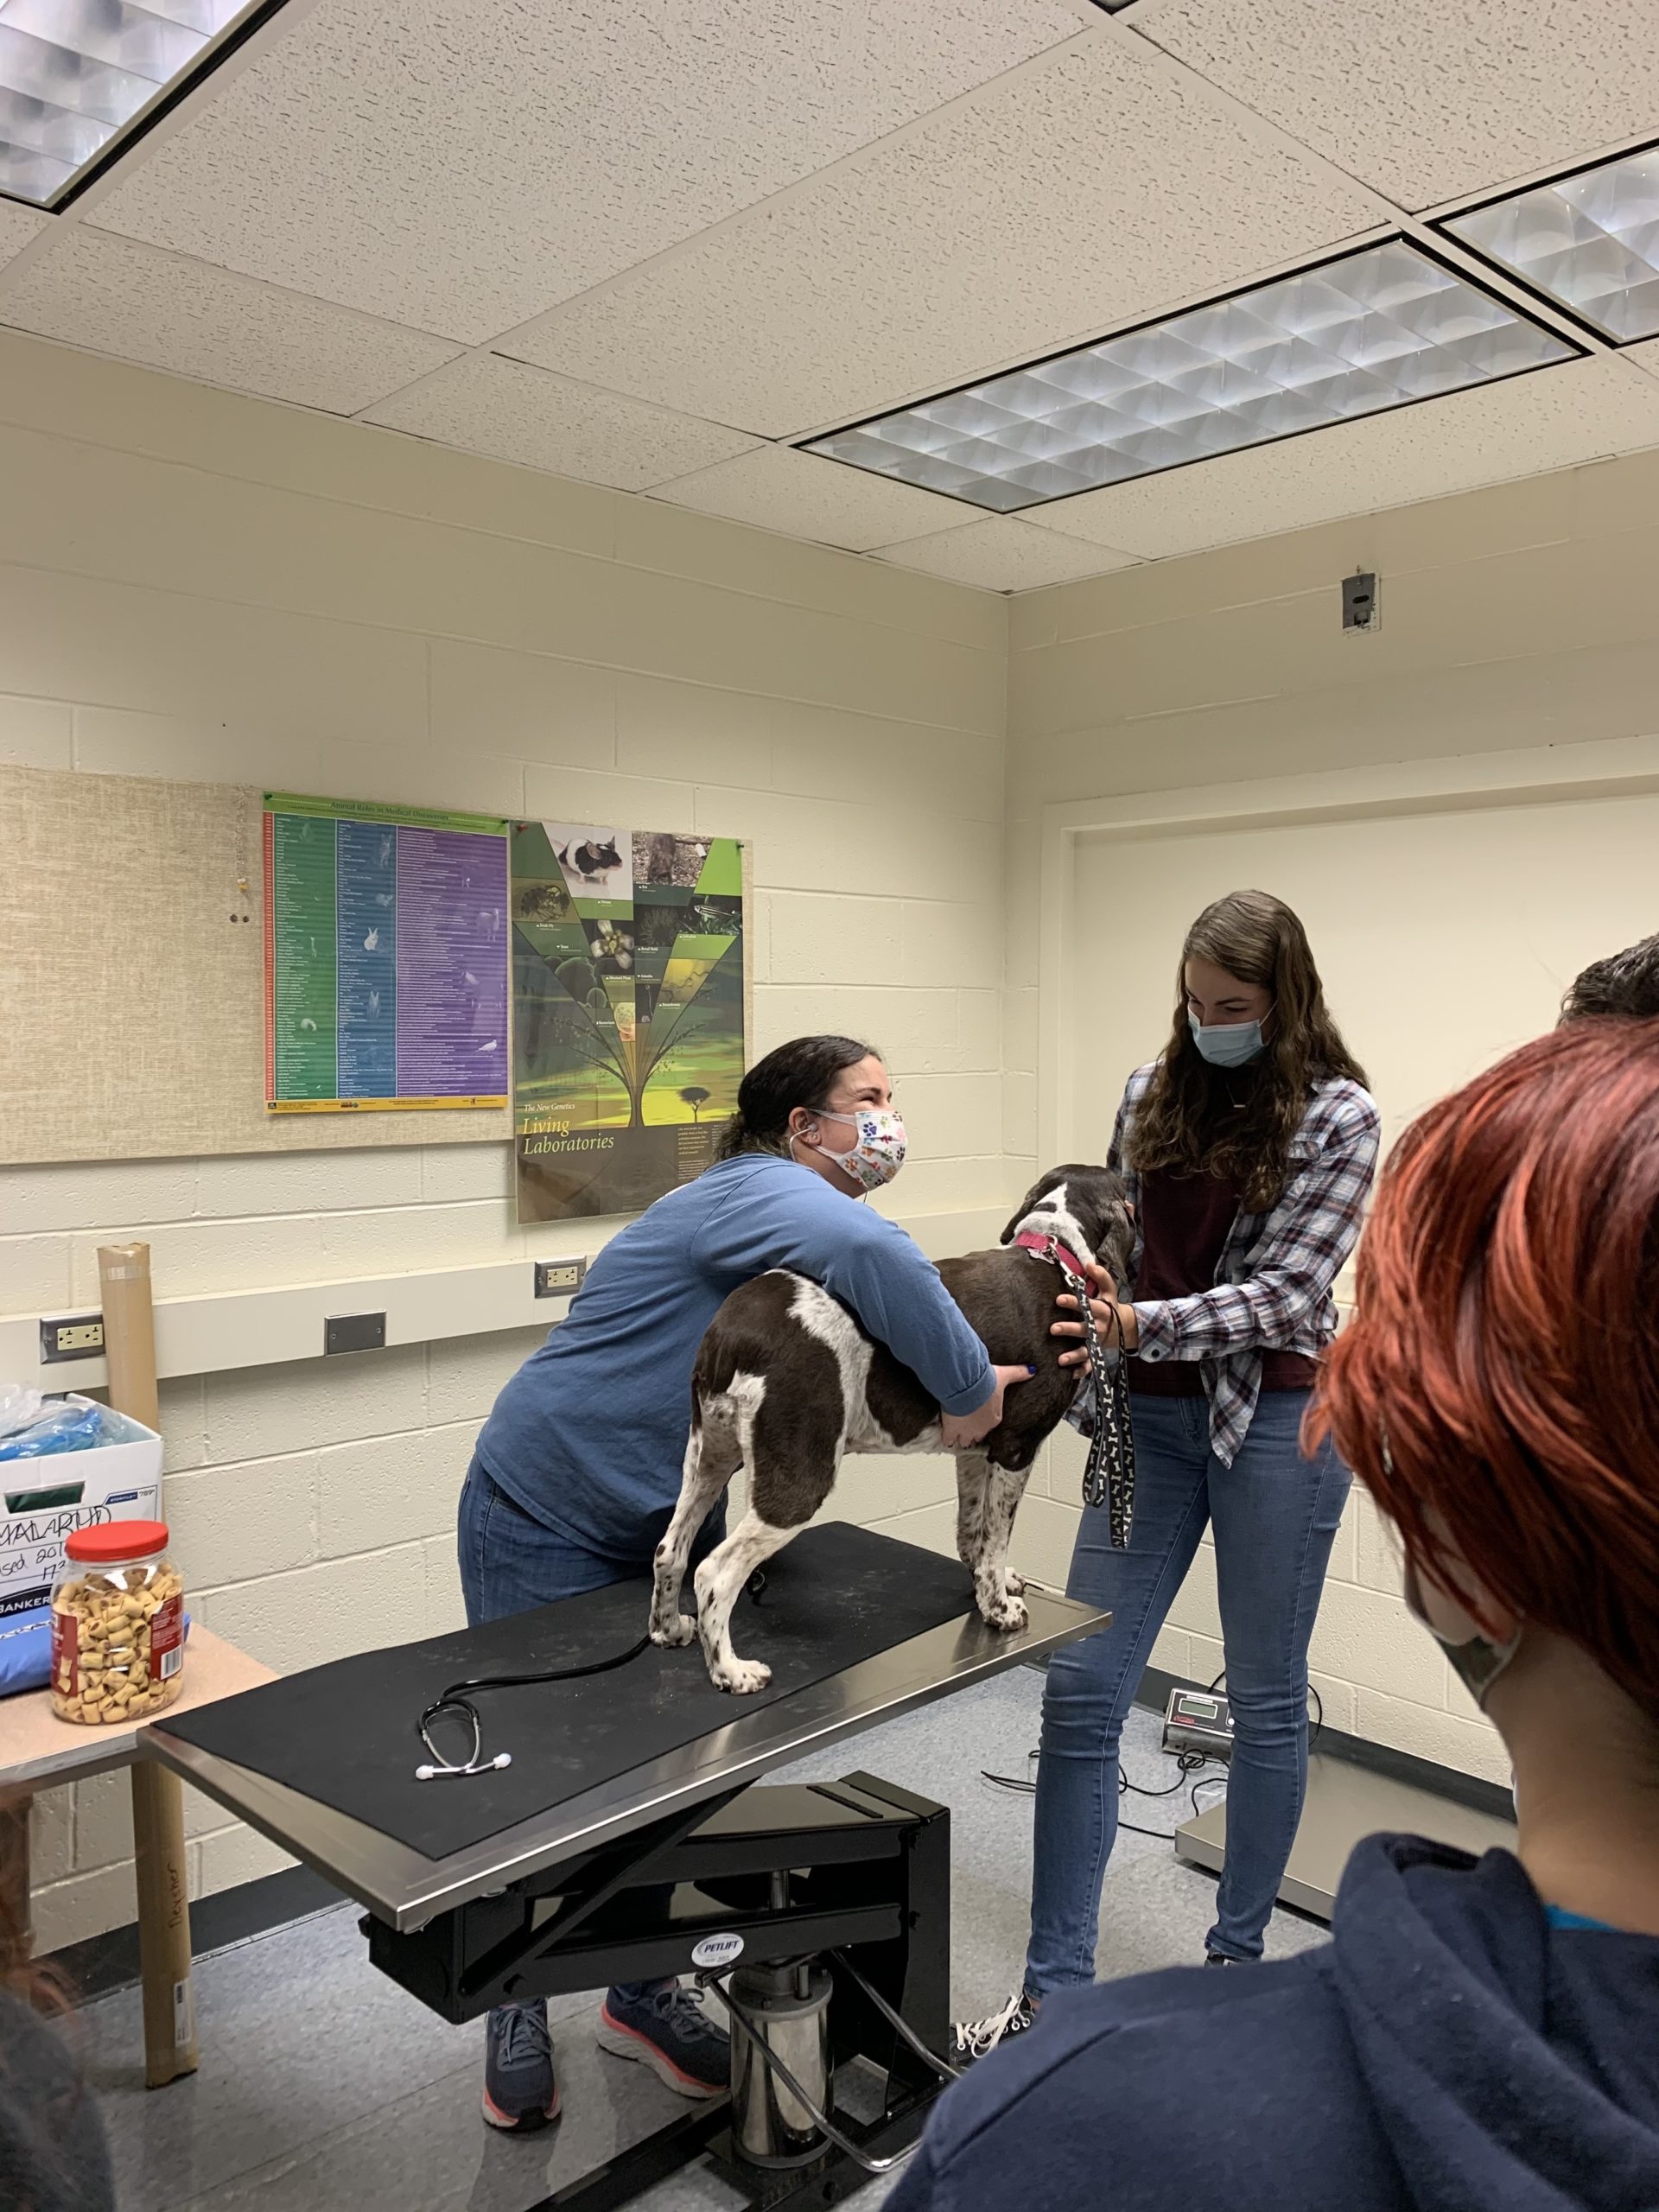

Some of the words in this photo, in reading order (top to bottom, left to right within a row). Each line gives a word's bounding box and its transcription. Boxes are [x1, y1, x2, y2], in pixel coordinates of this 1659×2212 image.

[330, 802, 355, 810] Animal
[385, 808, 411, 817] Medical
[414, 810, 449, 821] Discoveries
[524, 1103, 535, 1112] The
[523, 1116, 570, 1137] Living
[523, 1132, 614, 1155] Laboratories
[704, 1941, 739, 1953] PETLIFT
